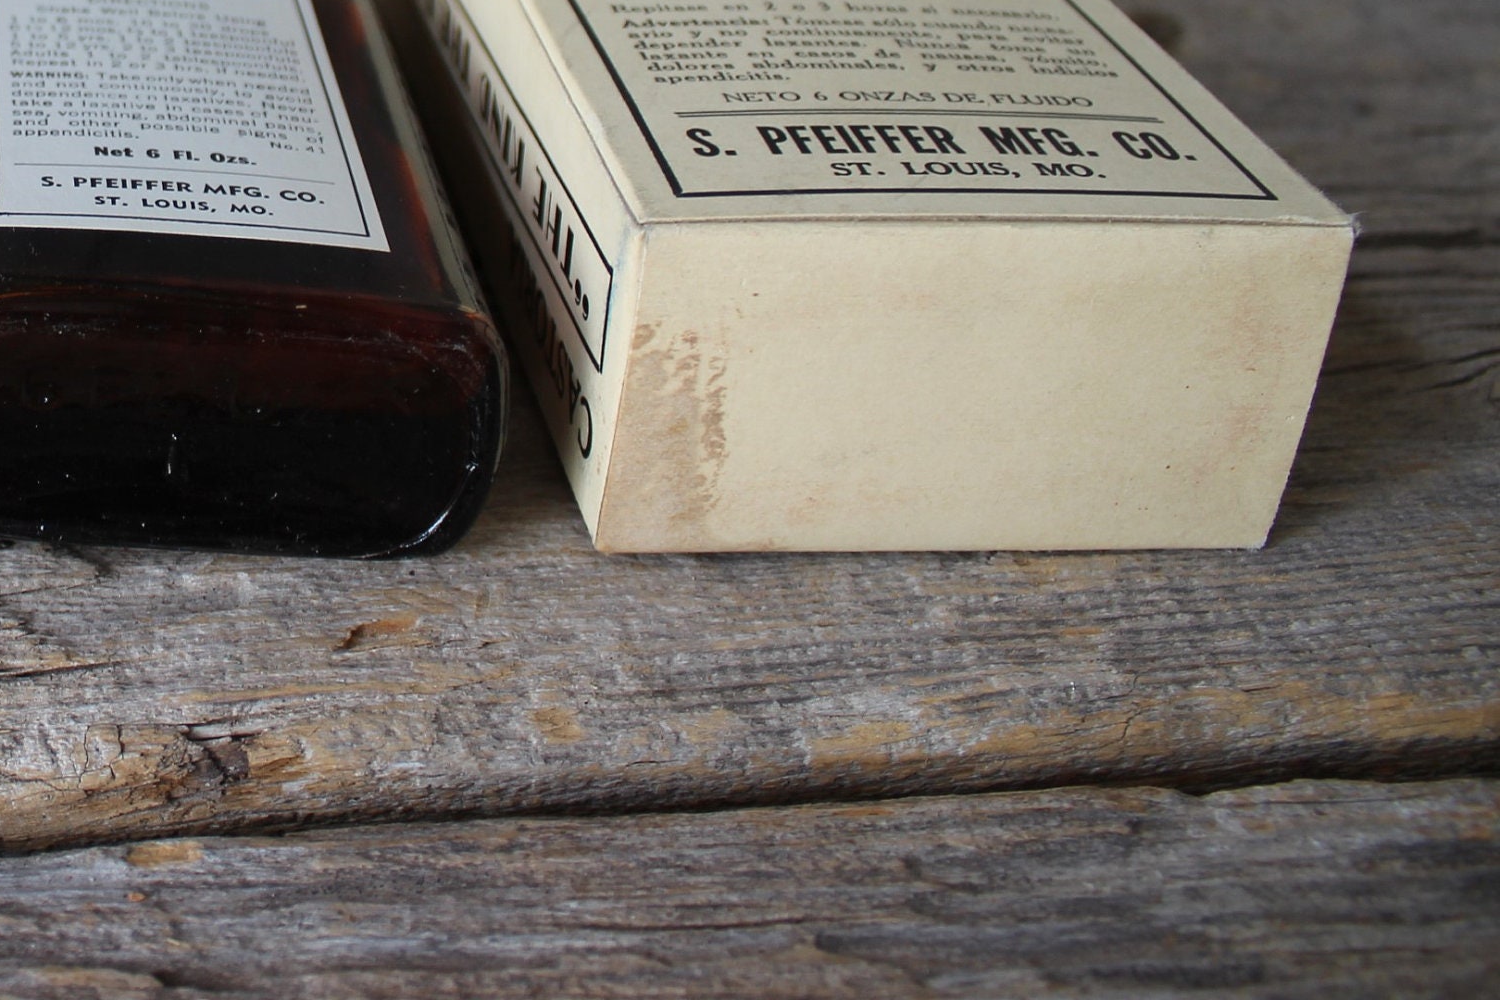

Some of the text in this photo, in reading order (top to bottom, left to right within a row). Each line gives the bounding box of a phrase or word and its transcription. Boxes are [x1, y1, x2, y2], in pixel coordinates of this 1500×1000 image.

[721, 91, 1094, 107] NETO 6 ONZAS DE FLUIDO
[685, 124, 1197, 161] S. PFEIFFER MFG. CO.
[93, 146, 257, 166] Net 6 Fl. Ozs.
[830, 161, 1107, 179] ST. LOUIS, MO.
[41, 176, 325, 205] S. PFEIFFER MFG. CO.
[94, 195, 274, 216] ST. LOUIS, MO.
